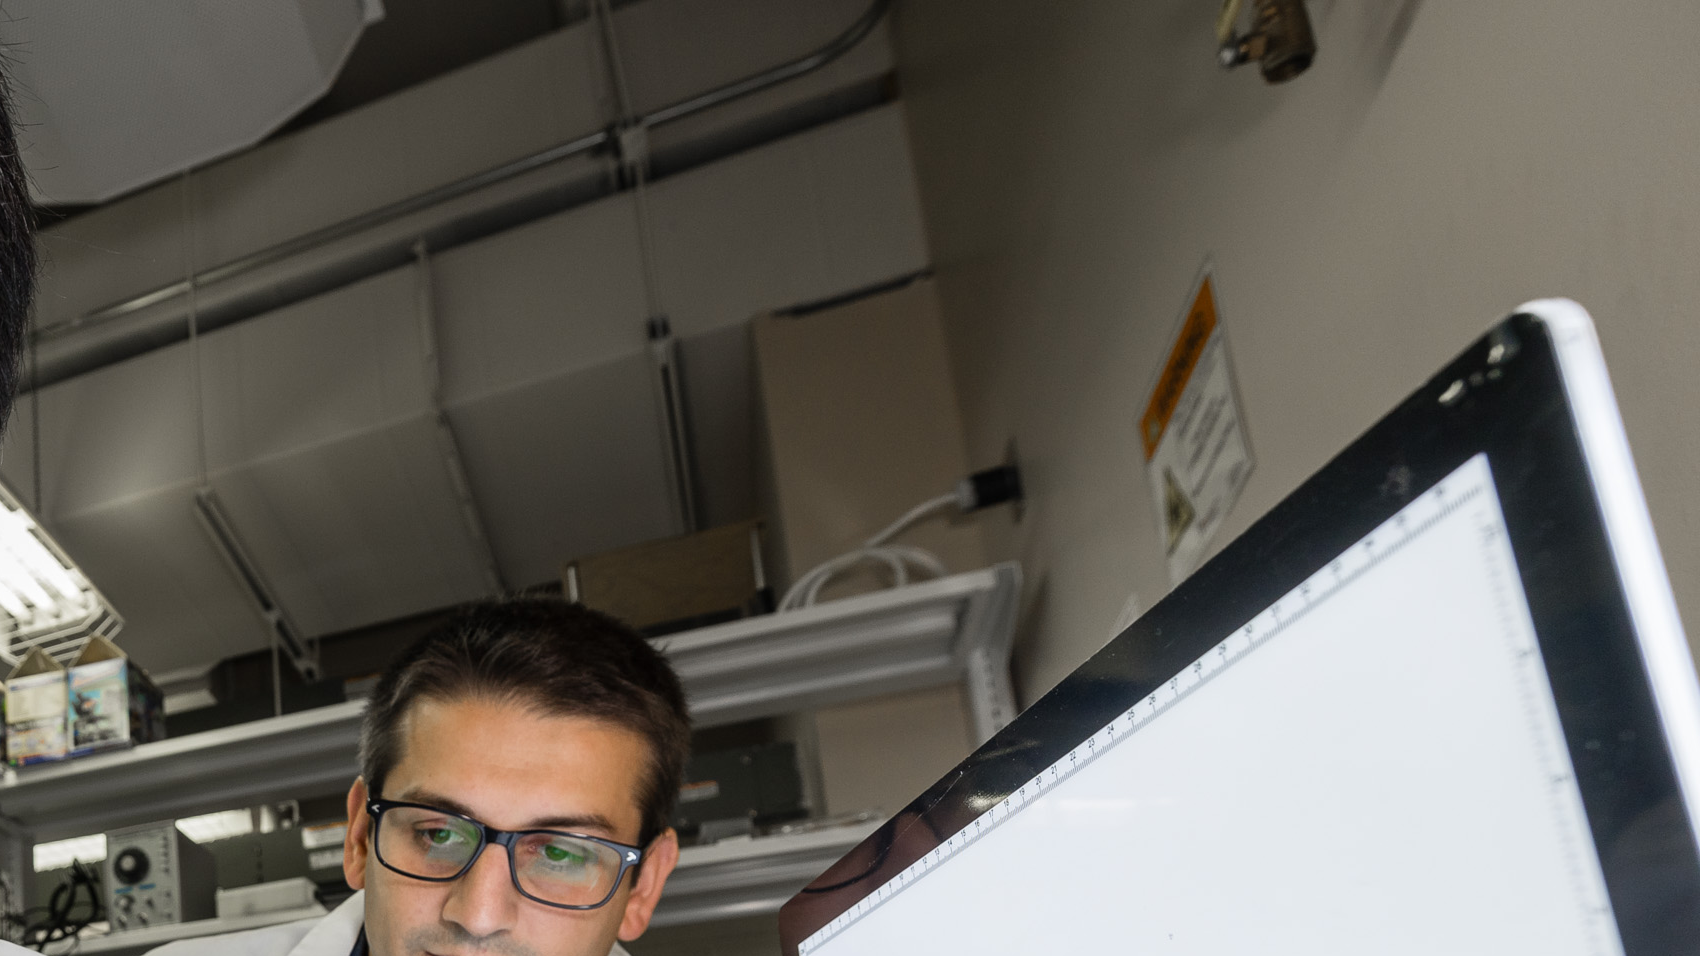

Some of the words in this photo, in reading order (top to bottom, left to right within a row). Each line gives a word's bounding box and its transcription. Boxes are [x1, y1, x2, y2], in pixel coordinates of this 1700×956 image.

[1019, 788, 1025, 796] 19
[1035, 776, 1042, 786] 20
[1051, 765, 1057, 775] 21
[1069, 751, 1076, 761] 22
[1087, 737, 1095, 748] 23
[1106, 724, 1114, 735] 24
[1126, 708, 1135, 720] 25
[1148, 693, 1157, 705] 26
